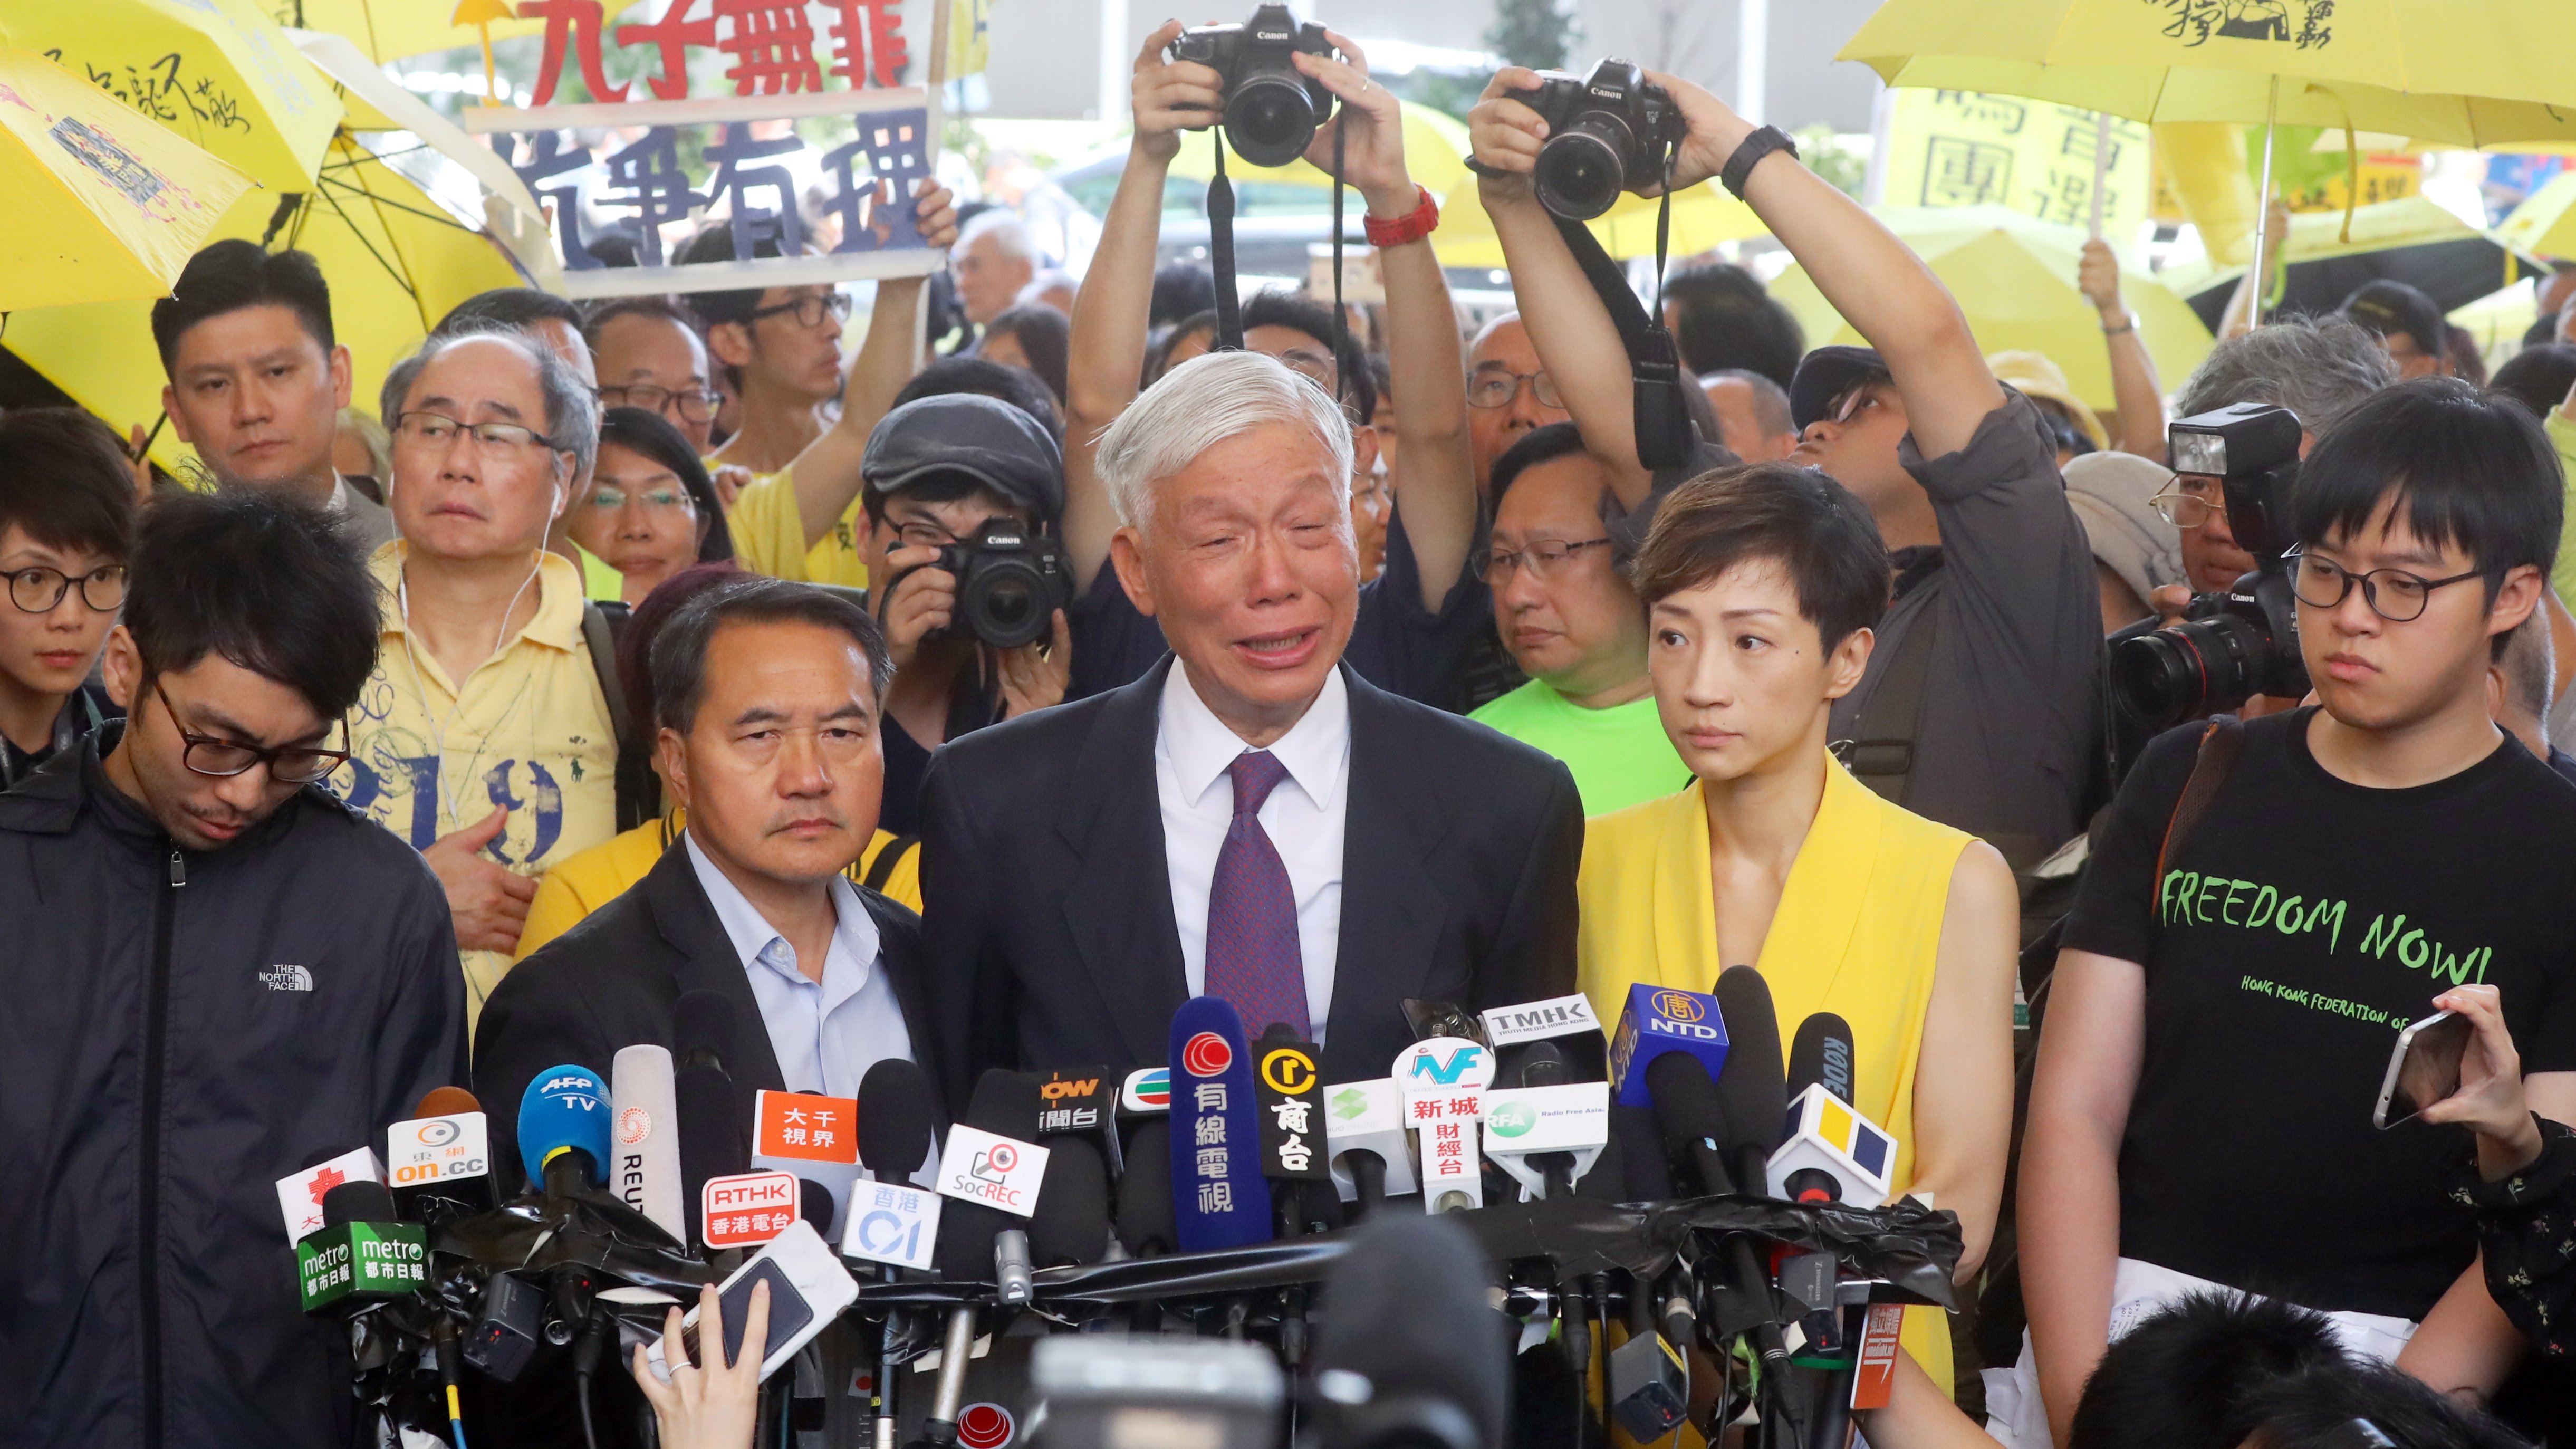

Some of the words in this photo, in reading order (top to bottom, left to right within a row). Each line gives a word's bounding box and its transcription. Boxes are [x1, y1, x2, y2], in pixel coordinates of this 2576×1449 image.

[1257, 31, 1289, 40] Canon
[1591, 87, 1622, 99] Canon
[987, 536, 1020, 544] Canon
[2231, 593, 2255, 602] Canon
[2160, 869, 2347, 955] FREEDOM
[259, 972, 294, 982] NORTH
[273, 964, 294, 974] THE
[268, 982, 295, 991] FACE
[2241, 975, 2273, 997] HONG
[2276, 984, 2308, 1005] KONG
[2311, 993, 2388, 1024] FEDERATION
[2391, 1017, 2410, 1033] OF
[1650, 1018, 1717, 1039] NTD
[540, 1077, 592, 1093] AFP
[562, 1096, 597, 1111] TV
[1414, 1097, 1479, 1119] 新城
[783, 1108, 837, 1127] 大千
[1488, 1113, 1525, 1128] RFA
[782, 1127, 835, 1148] 視界
[1271, 1096, 1312, 1172] 商台
[1193, 1083, 1234, 1214] 有線電視
[1436, 1123, 1463, 1175] 財經台
[396, 1159, 484, 1183] on.cc
[714, 1184, 787, 1205] RTHK
[873, 1187, 920, 1213] 香港
[953, 1174, 1021, 1206] SocREC
[712, 1213, 790, 1236] 香港電台
[304, 1243, 349, 1277] metro
[362, 1239, 424, 1261] metro
[307, 1265, 350, 1297] 都市日報
[365, 1261, 425, 1281] 都市日報
